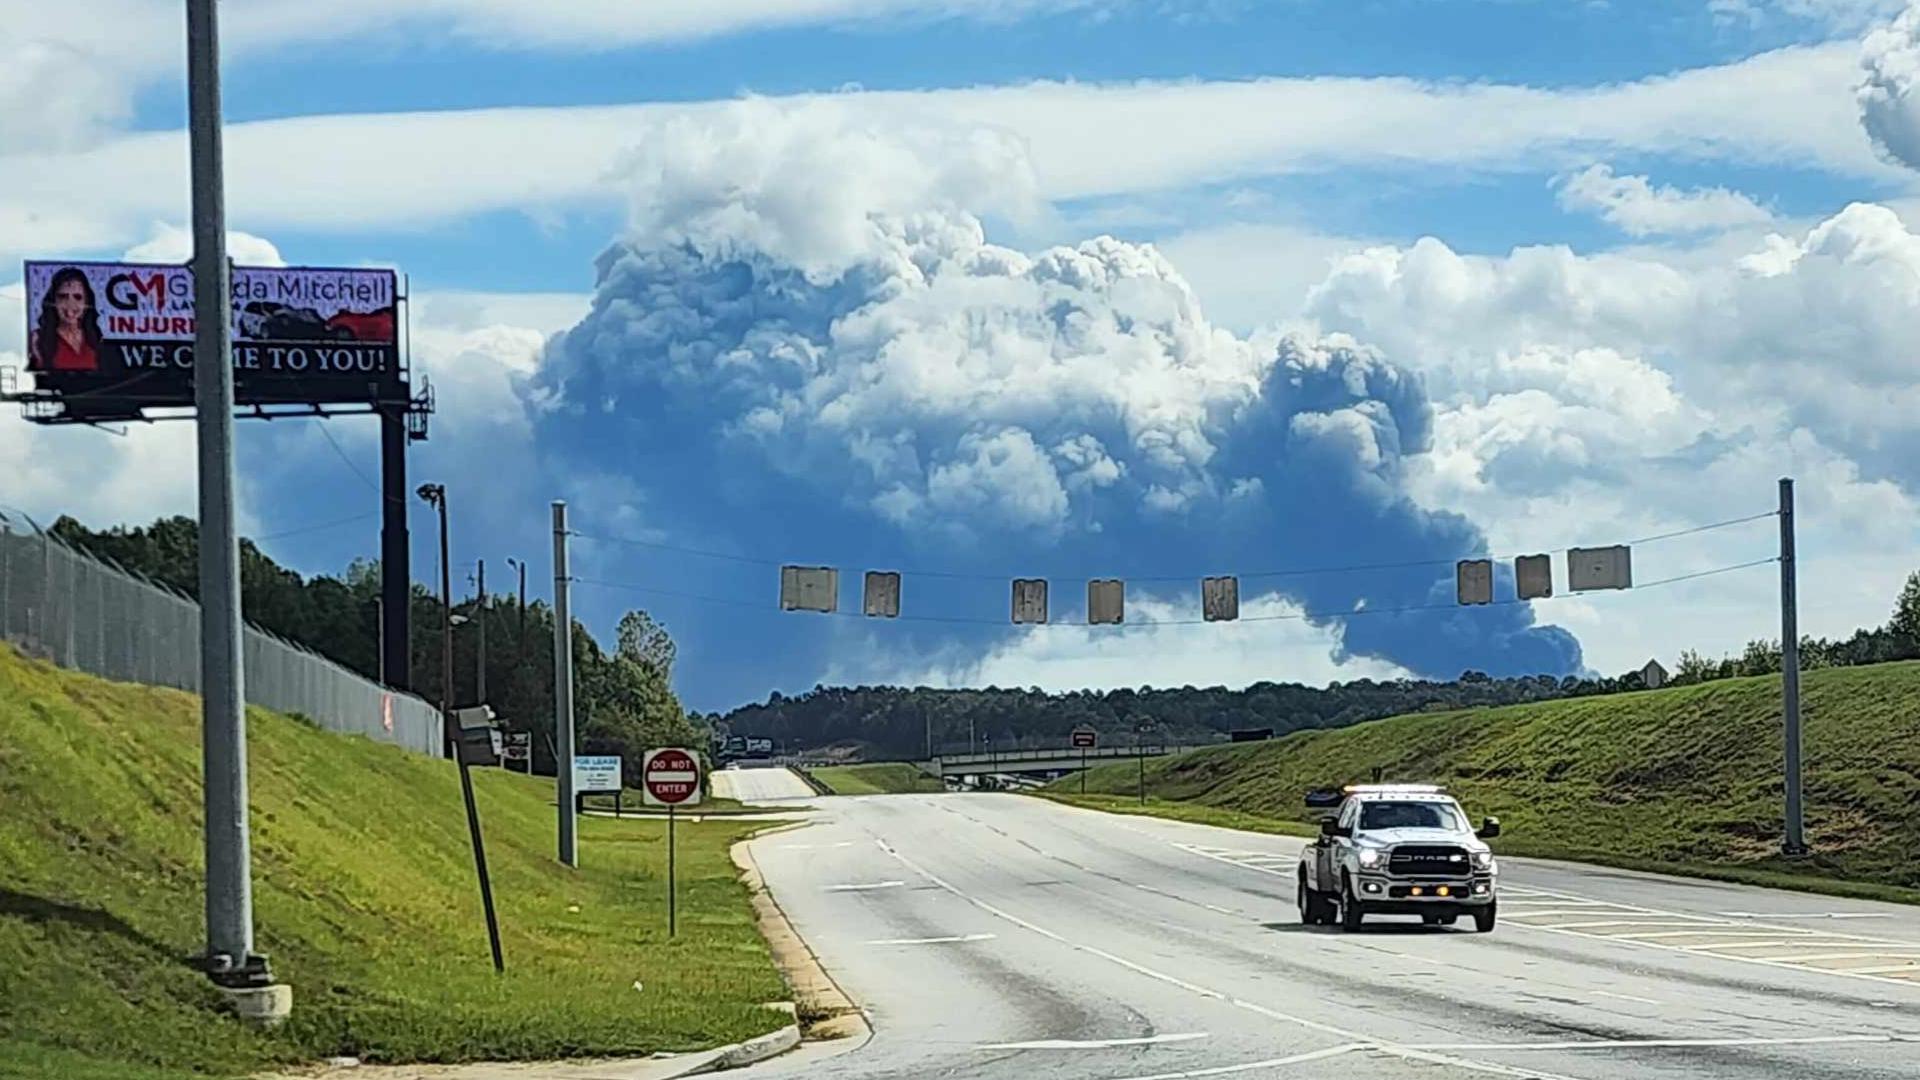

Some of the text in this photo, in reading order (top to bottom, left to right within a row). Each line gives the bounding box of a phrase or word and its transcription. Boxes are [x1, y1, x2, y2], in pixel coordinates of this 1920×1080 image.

[105, 271, 165, 314] GM
[278, 275, 385, 301] Mitchell
[120, 345, 167, 368] WE
[267, 347, 309, 371] TO
[314, 348, 386, 371] YOU!
[652, 760, 691, 769] DO NOT
[656, 784, 687, 794] ENTER
